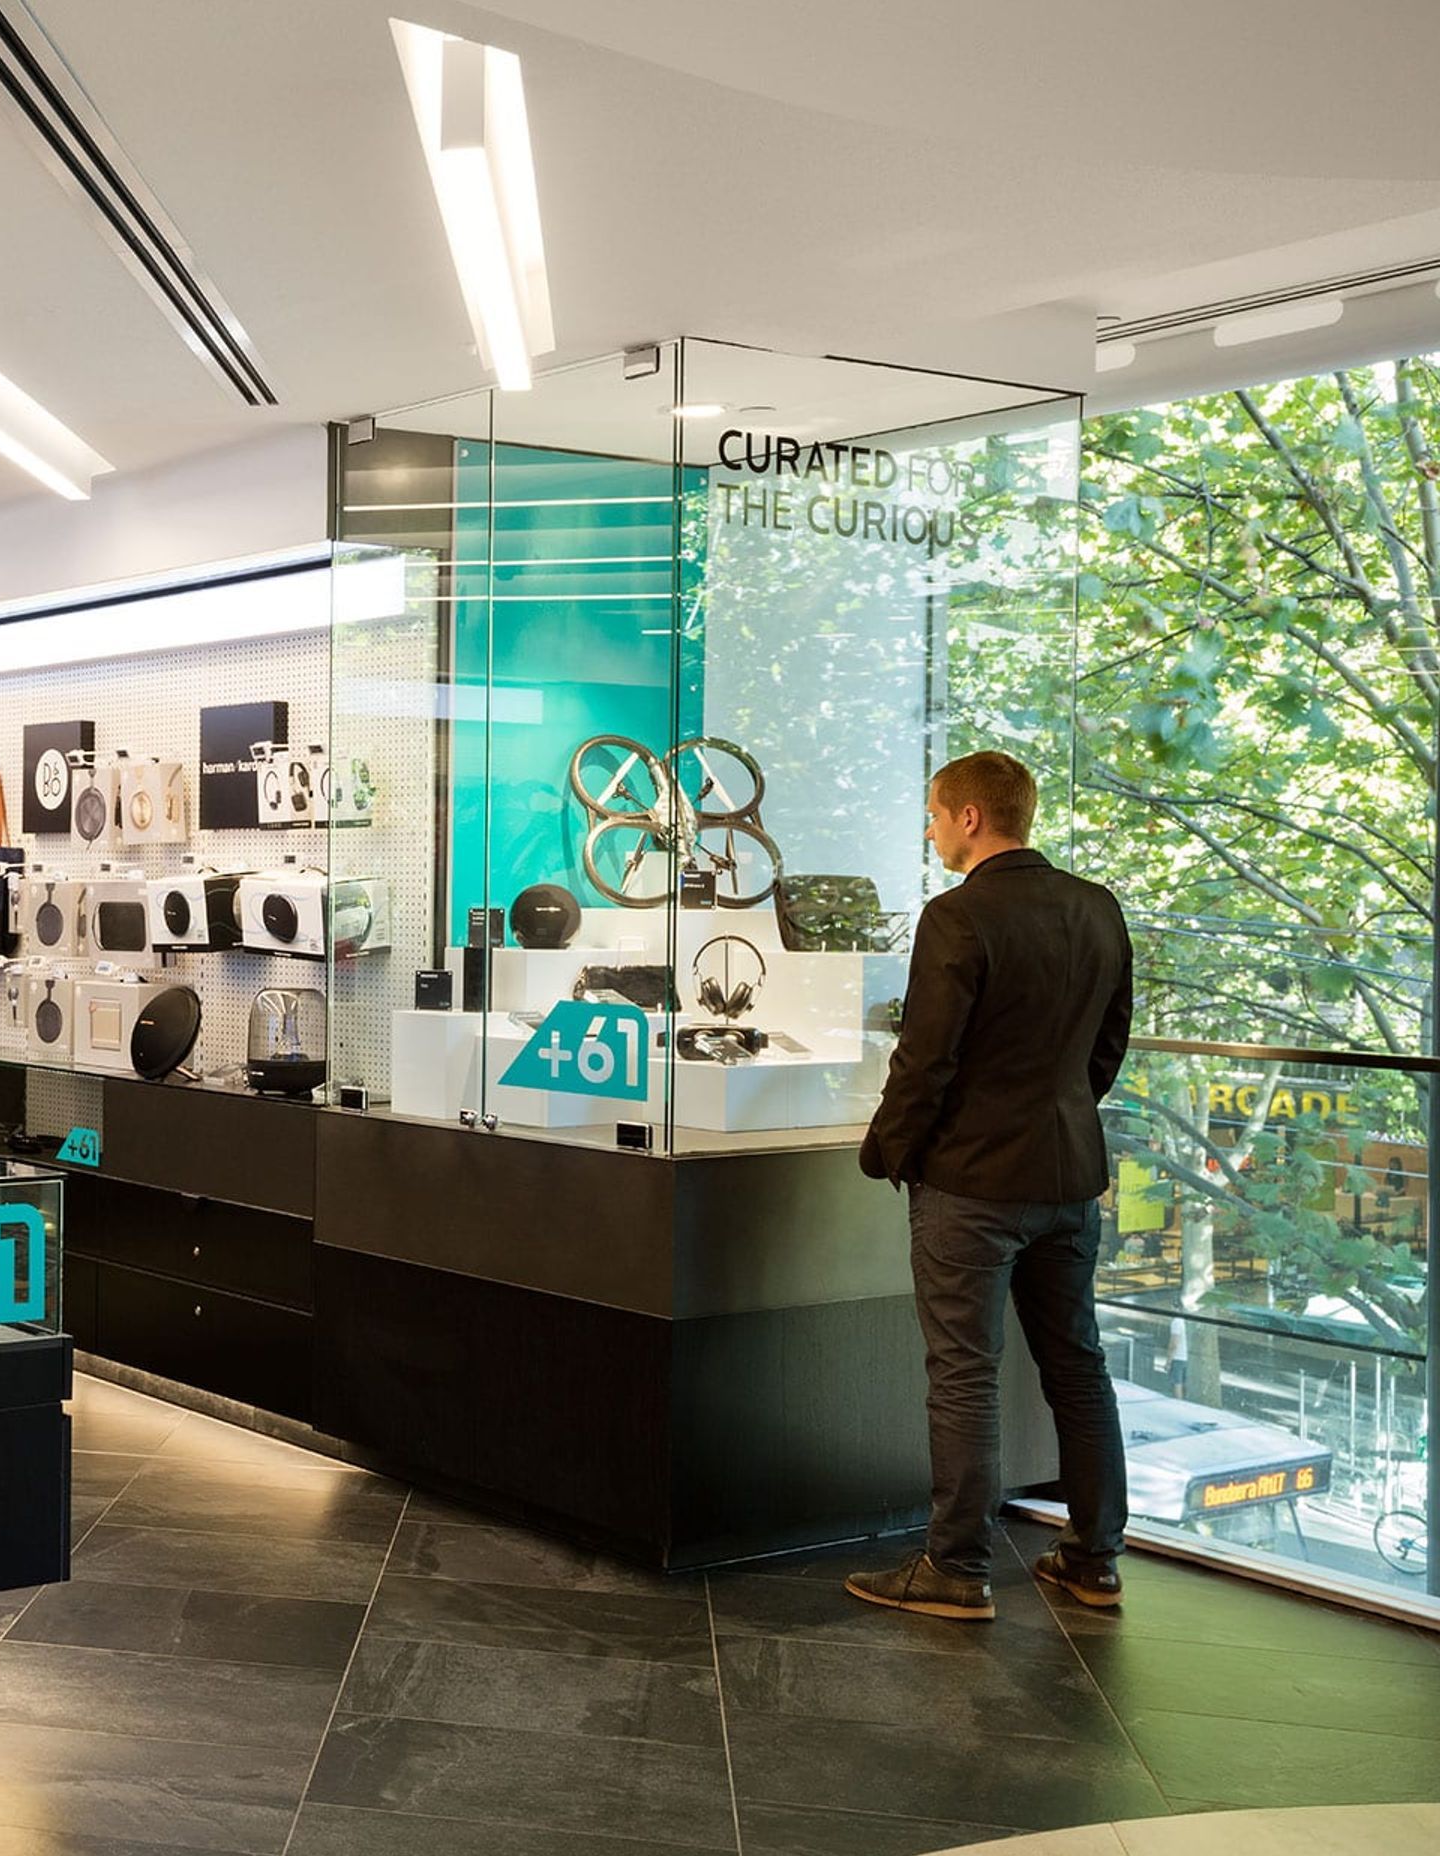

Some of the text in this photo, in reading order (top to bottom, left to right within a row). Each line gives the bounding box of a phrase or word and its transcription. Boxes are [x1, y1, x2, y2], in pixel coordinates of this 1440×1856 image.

[718, 430, 976, 499] CURATED FOR
[717, 483, 978, 550] THE CURIOUS
[538, 1016, 640, 1087] +61
[67, 1134, 96, 1161] +61
